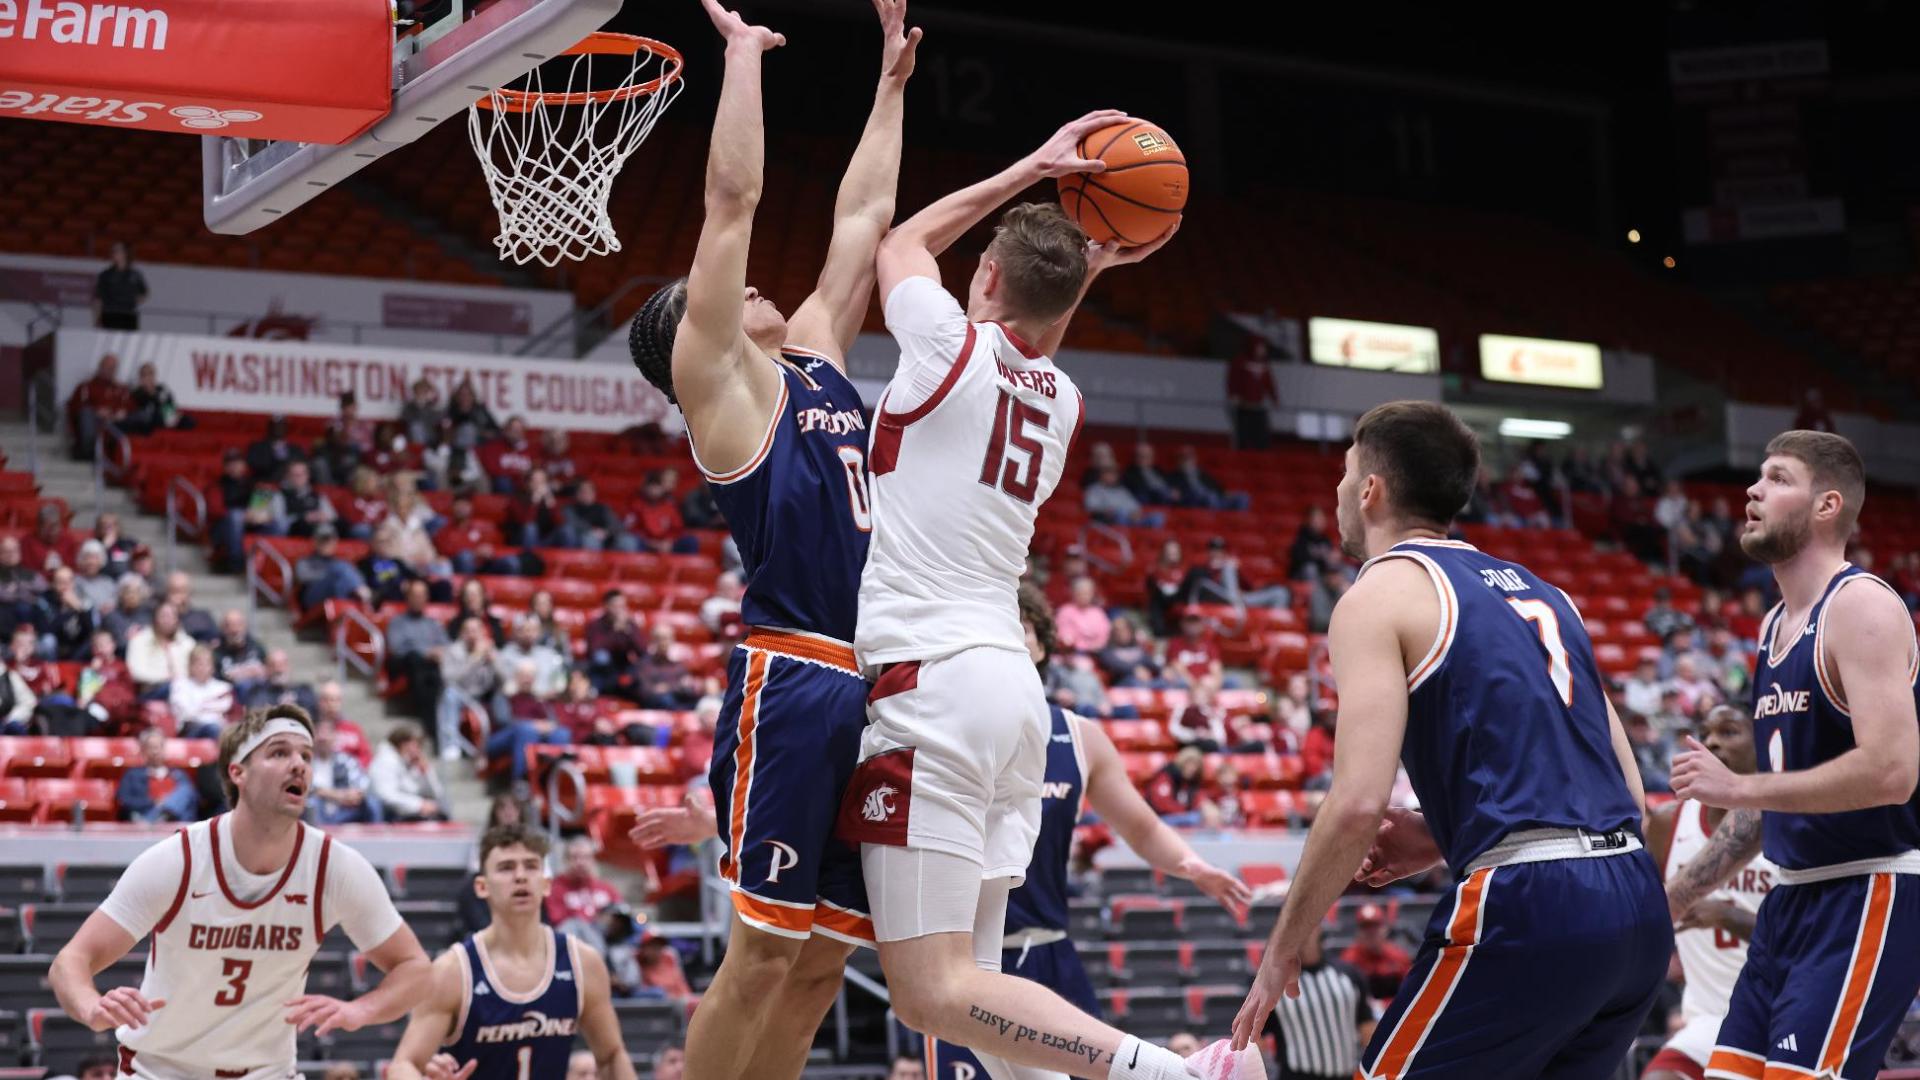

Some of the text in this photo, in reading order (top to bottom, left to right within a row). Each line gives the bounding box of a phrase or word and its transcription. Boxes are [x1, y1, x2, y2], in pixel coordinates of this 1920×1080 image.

[0, 90, 166, 123] State
[191, 350, 409, 402] WASHINGTON
[978, 384, 1050, 506] 15
[837, 445, 873, 533] 0
[1505, 596, 1573, 708] 7
[761, 839, 799, 884] P
[188, 923, 303, 951] COUGARS
[214, 957, 253, 1007] 3
[969, 1004, 1014, 1036] Astra
[1014, 1024, 1038, 1041] ad
[1041, 1033, 1103, 1065] Aspera
